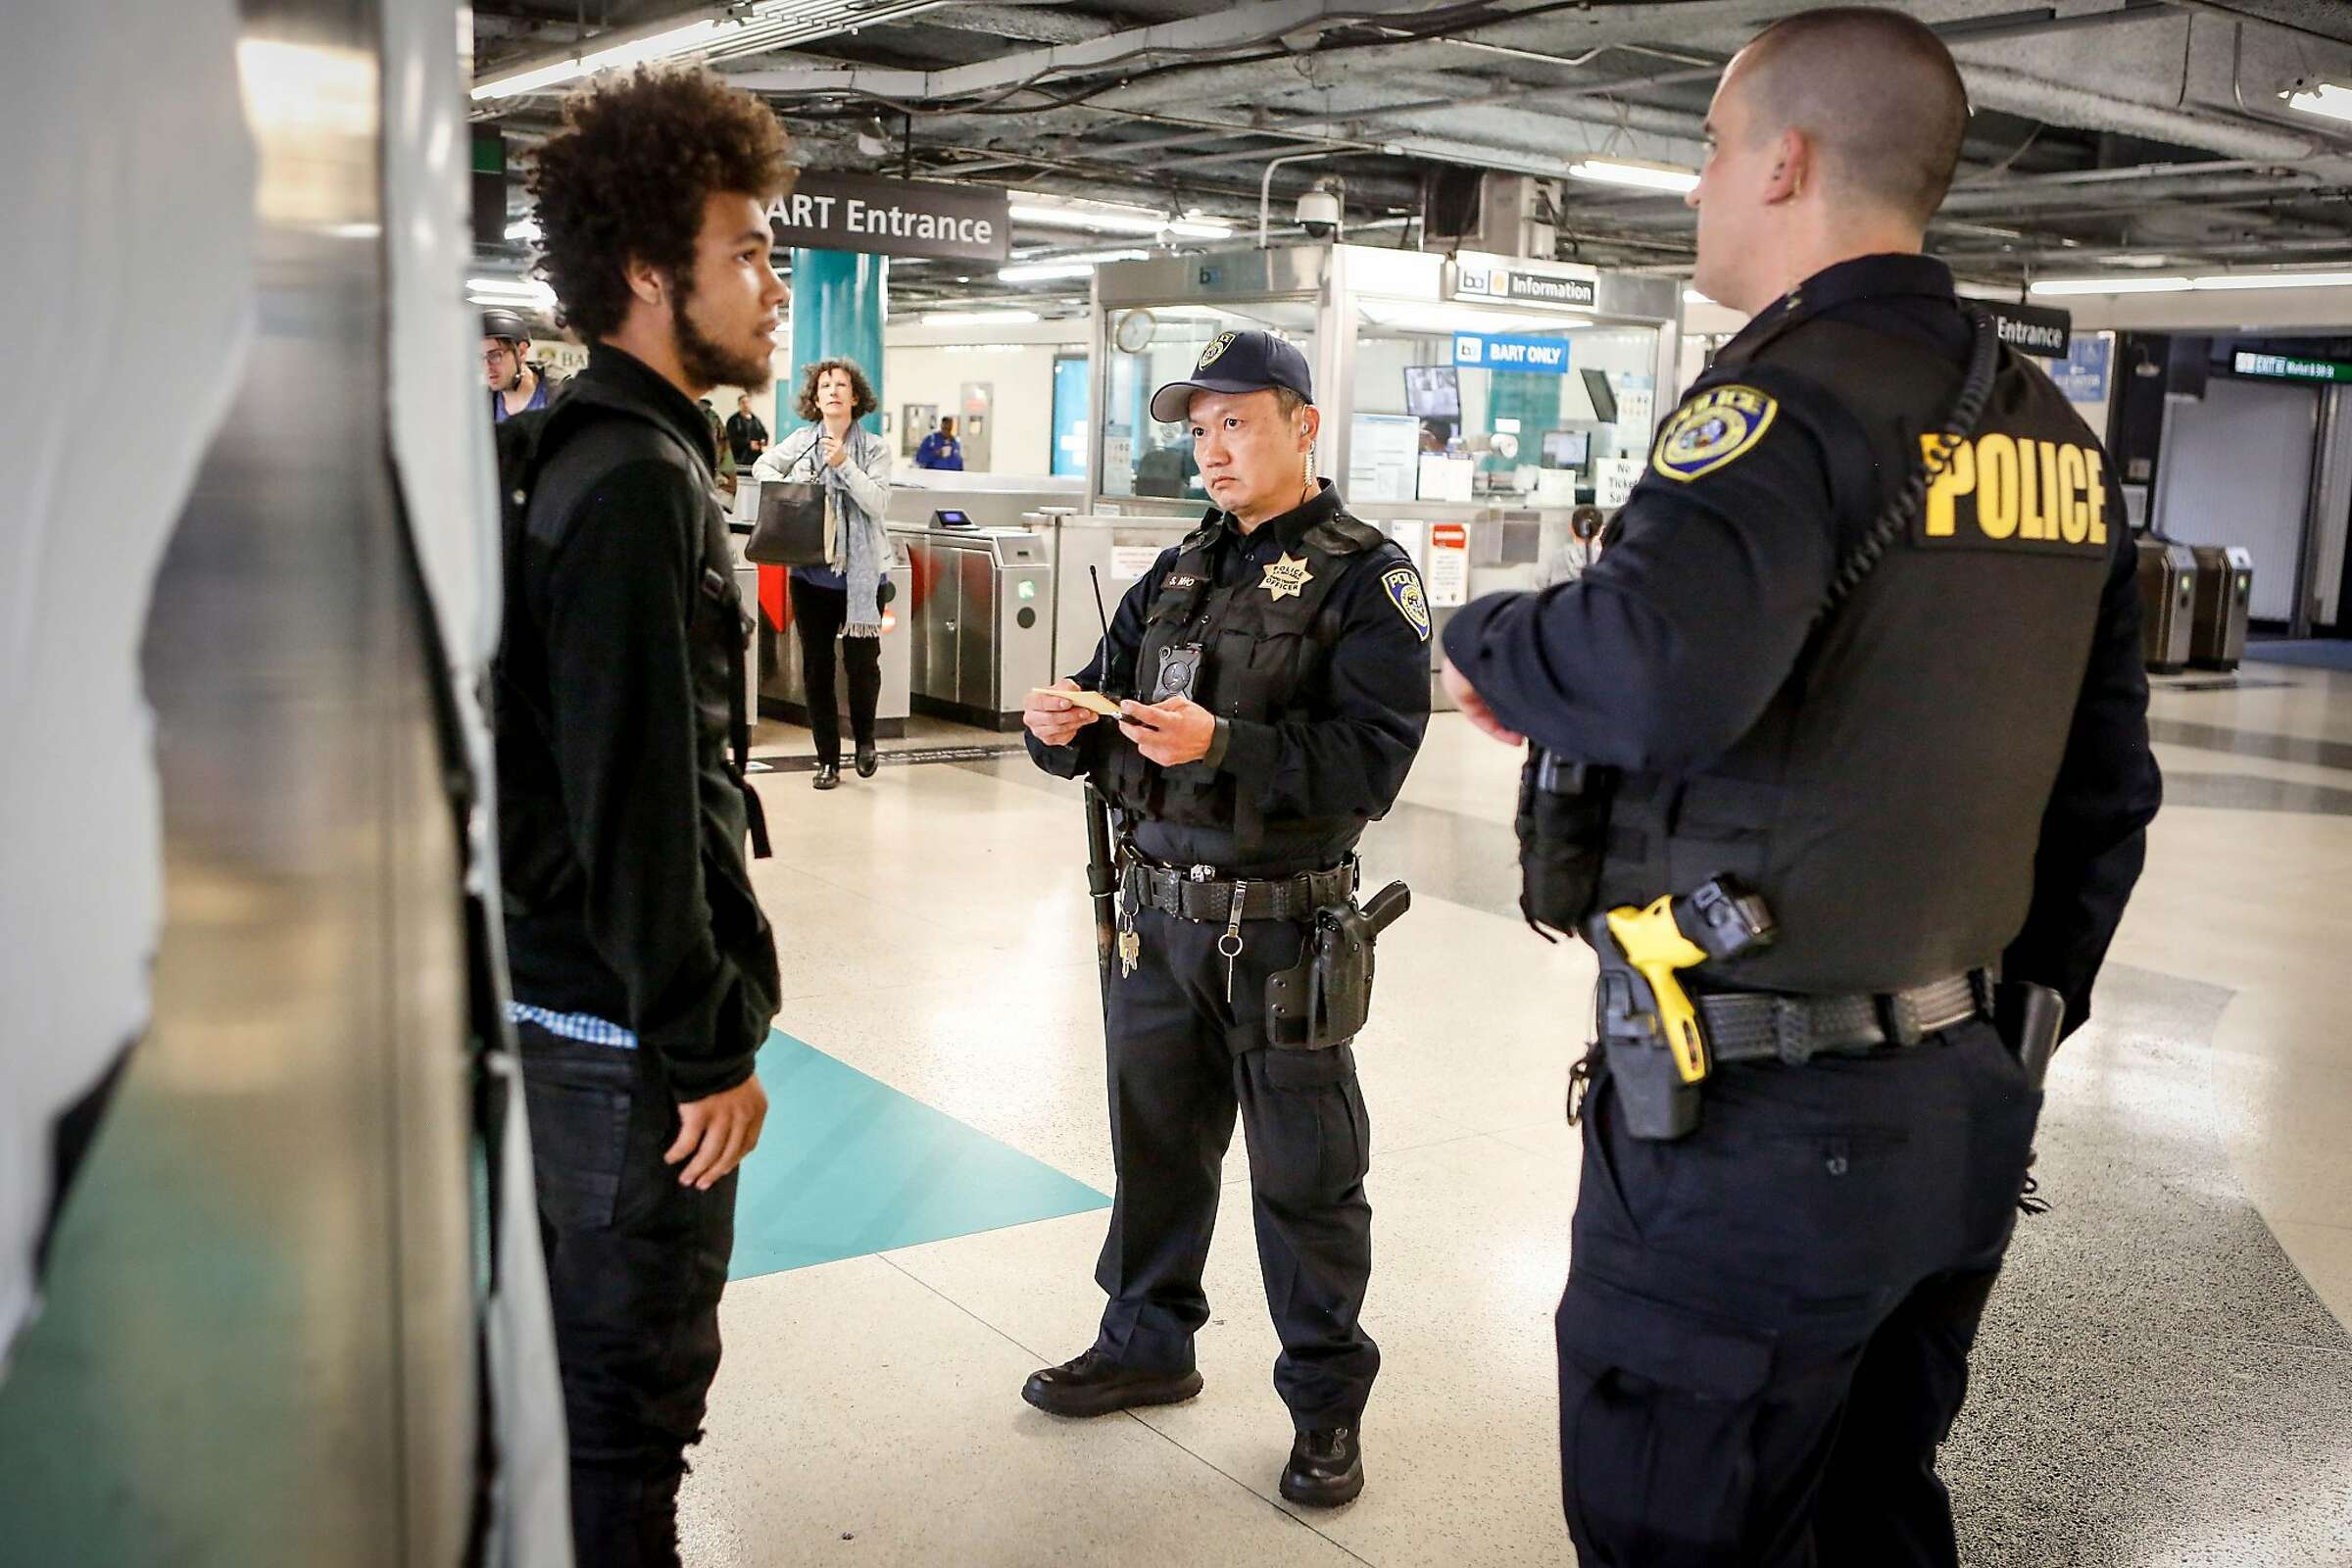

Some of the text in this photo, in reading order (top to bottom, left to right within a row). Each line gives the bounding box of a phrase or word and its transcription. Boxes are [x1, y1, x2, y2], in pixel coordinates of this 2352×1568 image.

[764, 193, 994, 244] ART Entrance
[1512, 275, 1592, 302] Information
[1996, 315, 2064, 349] Entrance
[1490, 343, 1526, 362] BART
[1527, 346, 1562, 366] ONLY
[1920, 432, 2107, 546] POLICE
[1265, 576, 1299, 591] OFFICER
[1273, 564, 1304, 578] POLICE
